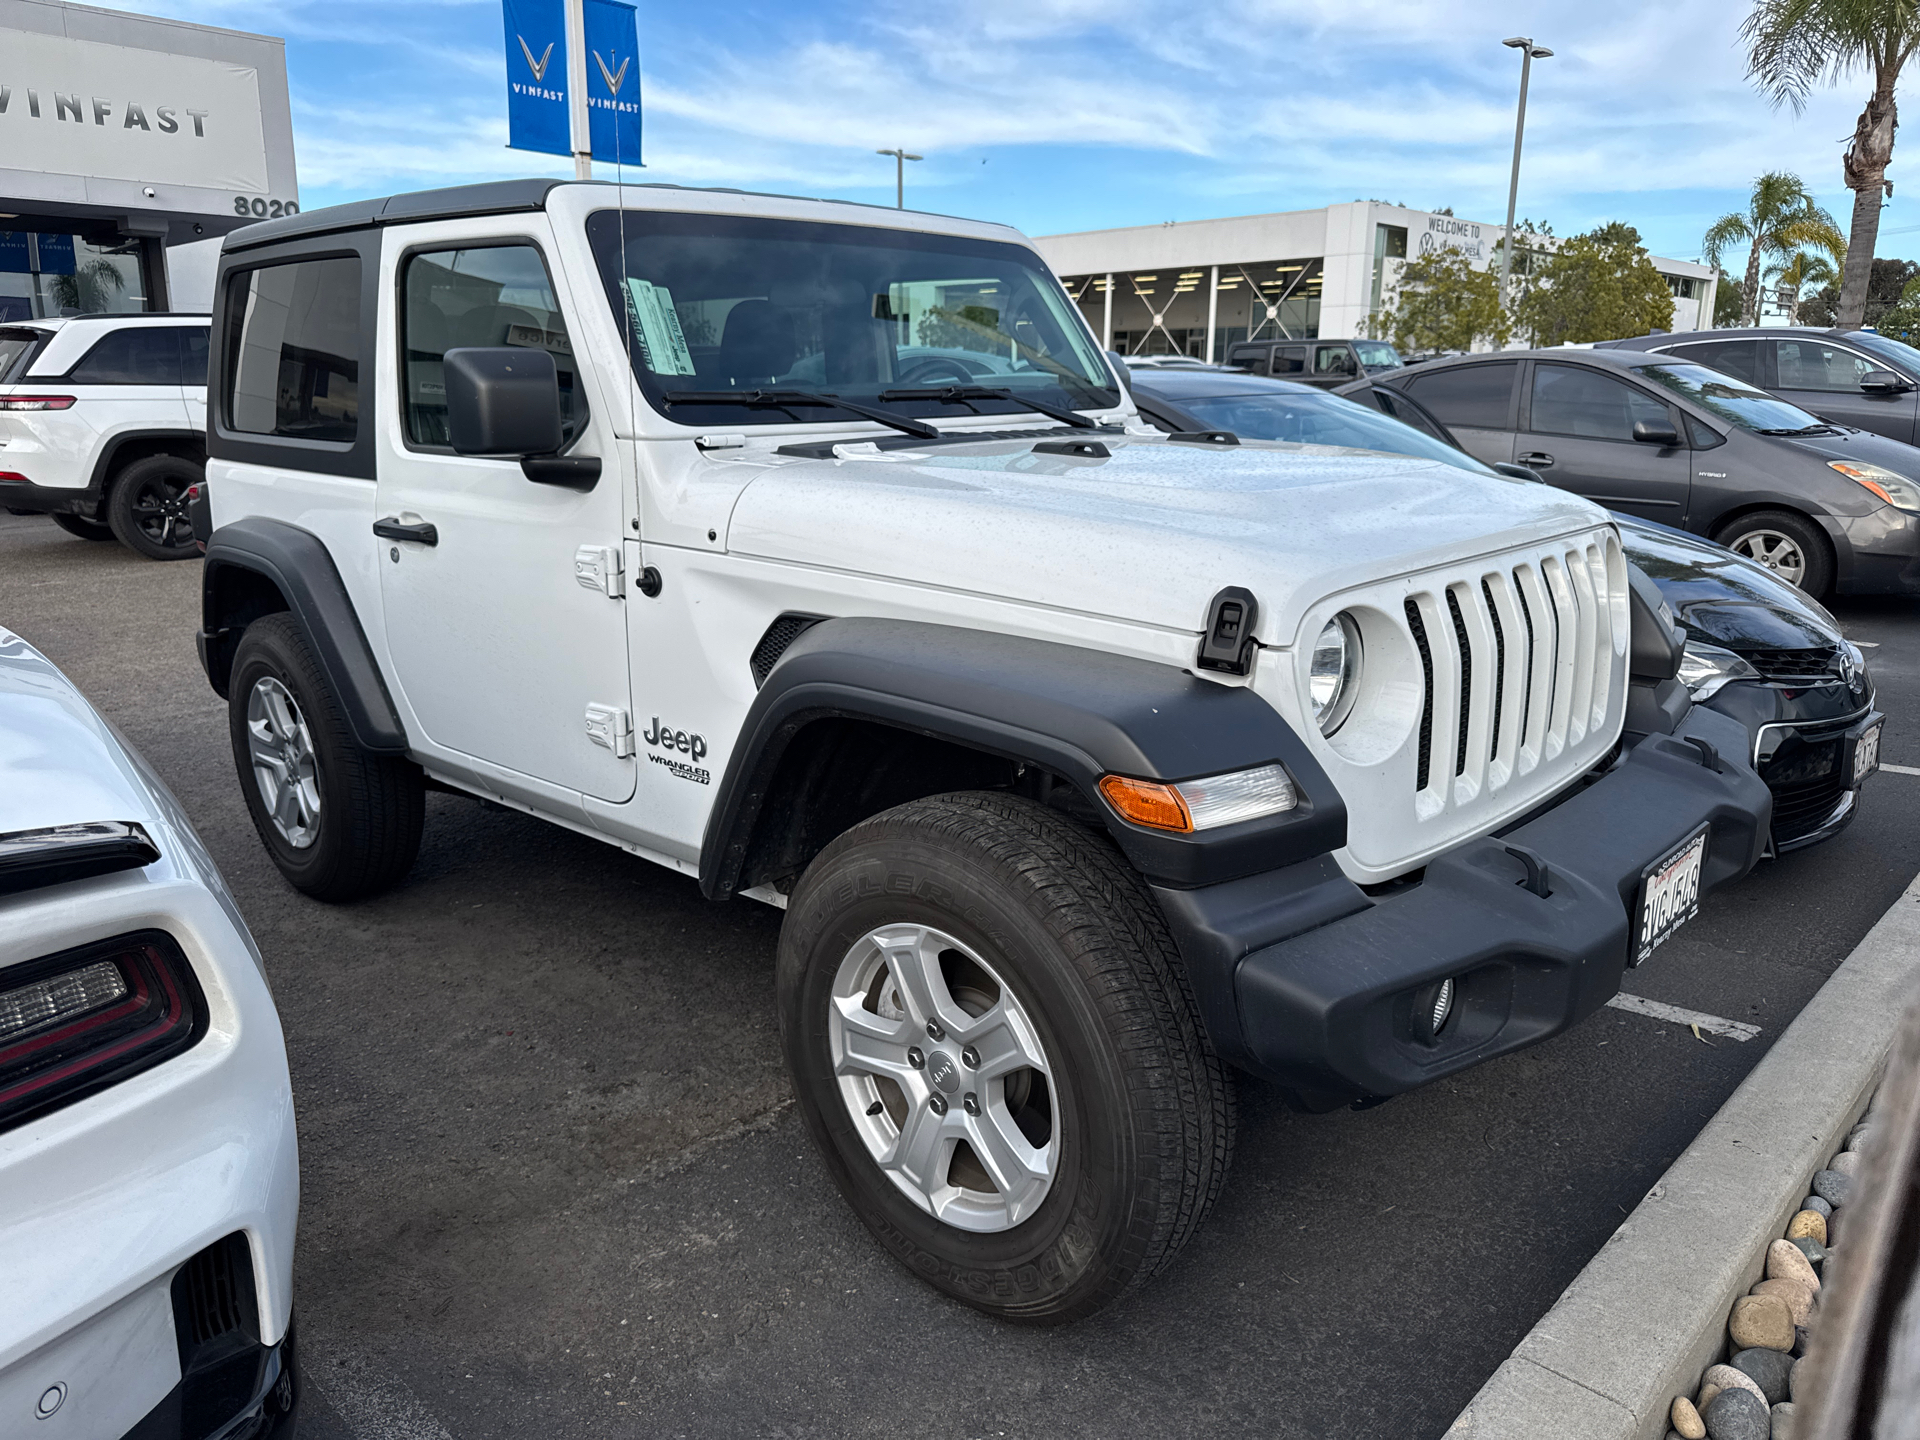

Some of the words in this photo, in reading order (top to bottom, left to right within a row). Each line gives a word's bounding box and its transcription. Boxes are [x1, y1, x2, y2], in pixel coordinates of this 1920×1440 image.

[513, 82, 564, 102] VINFAST
[588, 97, 639, 114] VINFAST
[234, 195, 301, 218] 8020
[1428, 217, 1468, 237] WELCOME
[1471, 225, 1480, 239] TO
[667, 308, 680, 332] Kearny
[677, 334, 687, 354] Mesa
[643, 714, 707, 763] Jeep
[647, 753, 710, 778] WRANGLER
[669, 768, 710, 785] SPORT
[1642, 862, 1699, 945] 8VGJ548
[1652, 927, 1672, 950] Kearny
[1671, 914, 1686, 933] Mesa
[933, 1061, 952, 1083] Jeep
